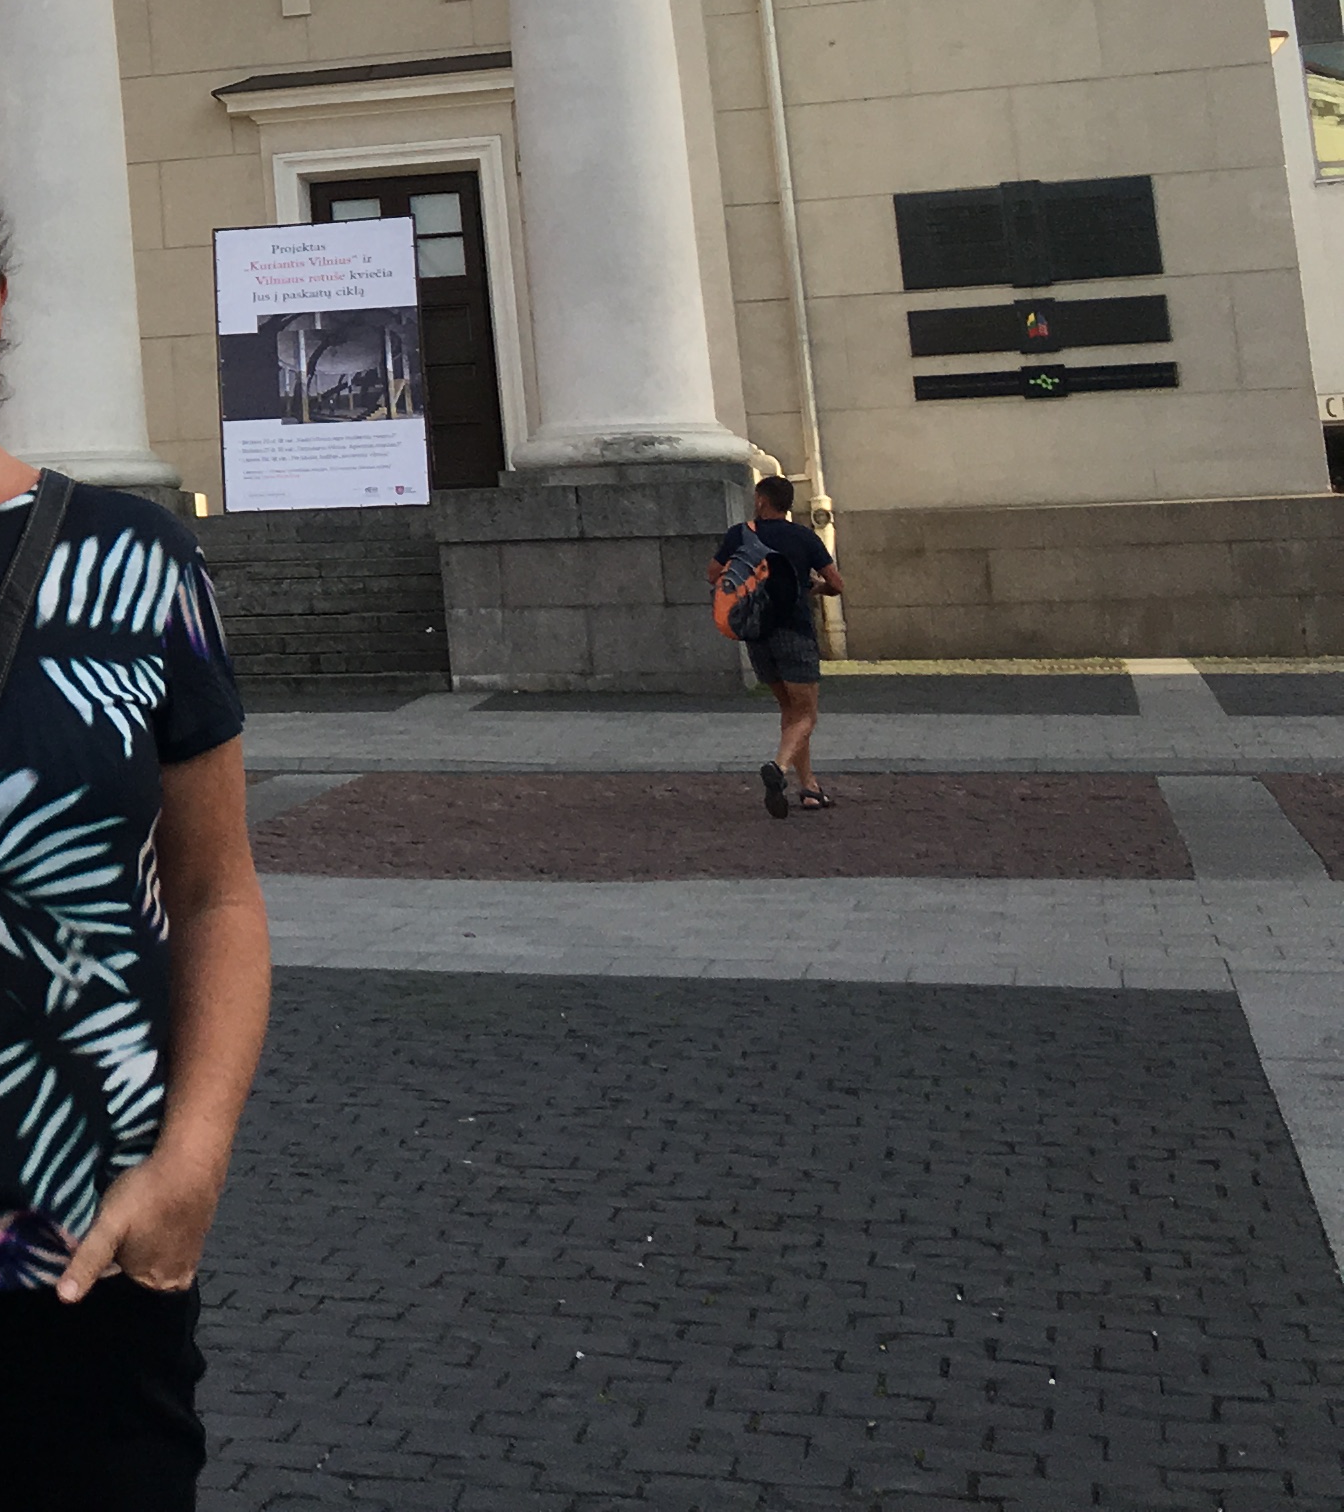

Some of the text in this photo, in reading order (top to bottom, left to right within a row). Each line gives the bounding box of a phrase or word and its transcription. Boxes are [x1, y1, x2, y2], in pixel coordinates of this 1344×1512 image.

[271, 242, 326, 255] Projektas
[362, 254, 372, 264] ir
[255, 275, 305, 286] Vilniaus
[349, 268, 393, 280] kviečia
[252, 291, 271, 303] Jus
[282, 288, 332, 303] paskaitų
